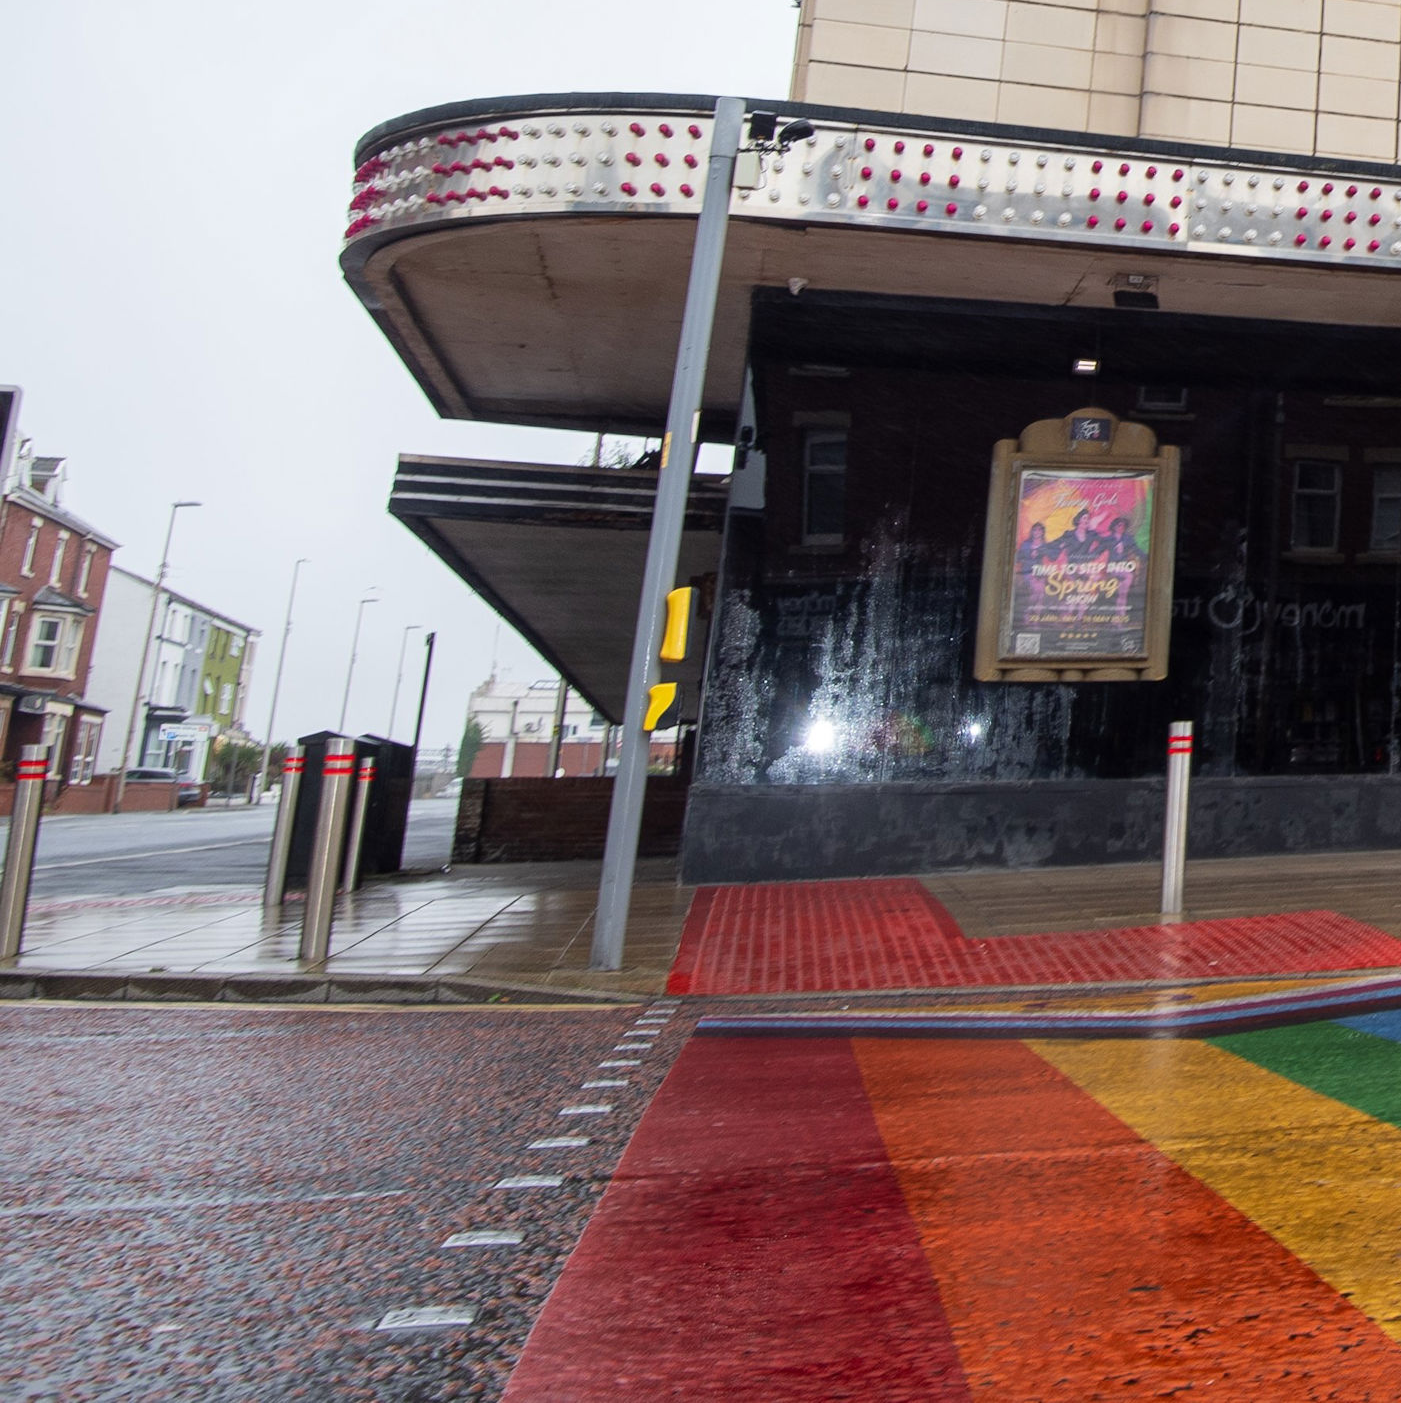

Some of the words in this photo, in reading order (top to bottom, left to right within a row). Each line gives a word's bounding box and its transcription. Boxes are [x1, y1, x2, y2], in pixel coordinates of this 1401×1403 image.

[1062, 563, 1077, 575] TO
[1078, 561, 1106, 574] STEP
[1107, 560, 1137, 573] INTO
[1045, 571, 1119, 601] Spring
[1066, 594, 1100, 606] SHOW
